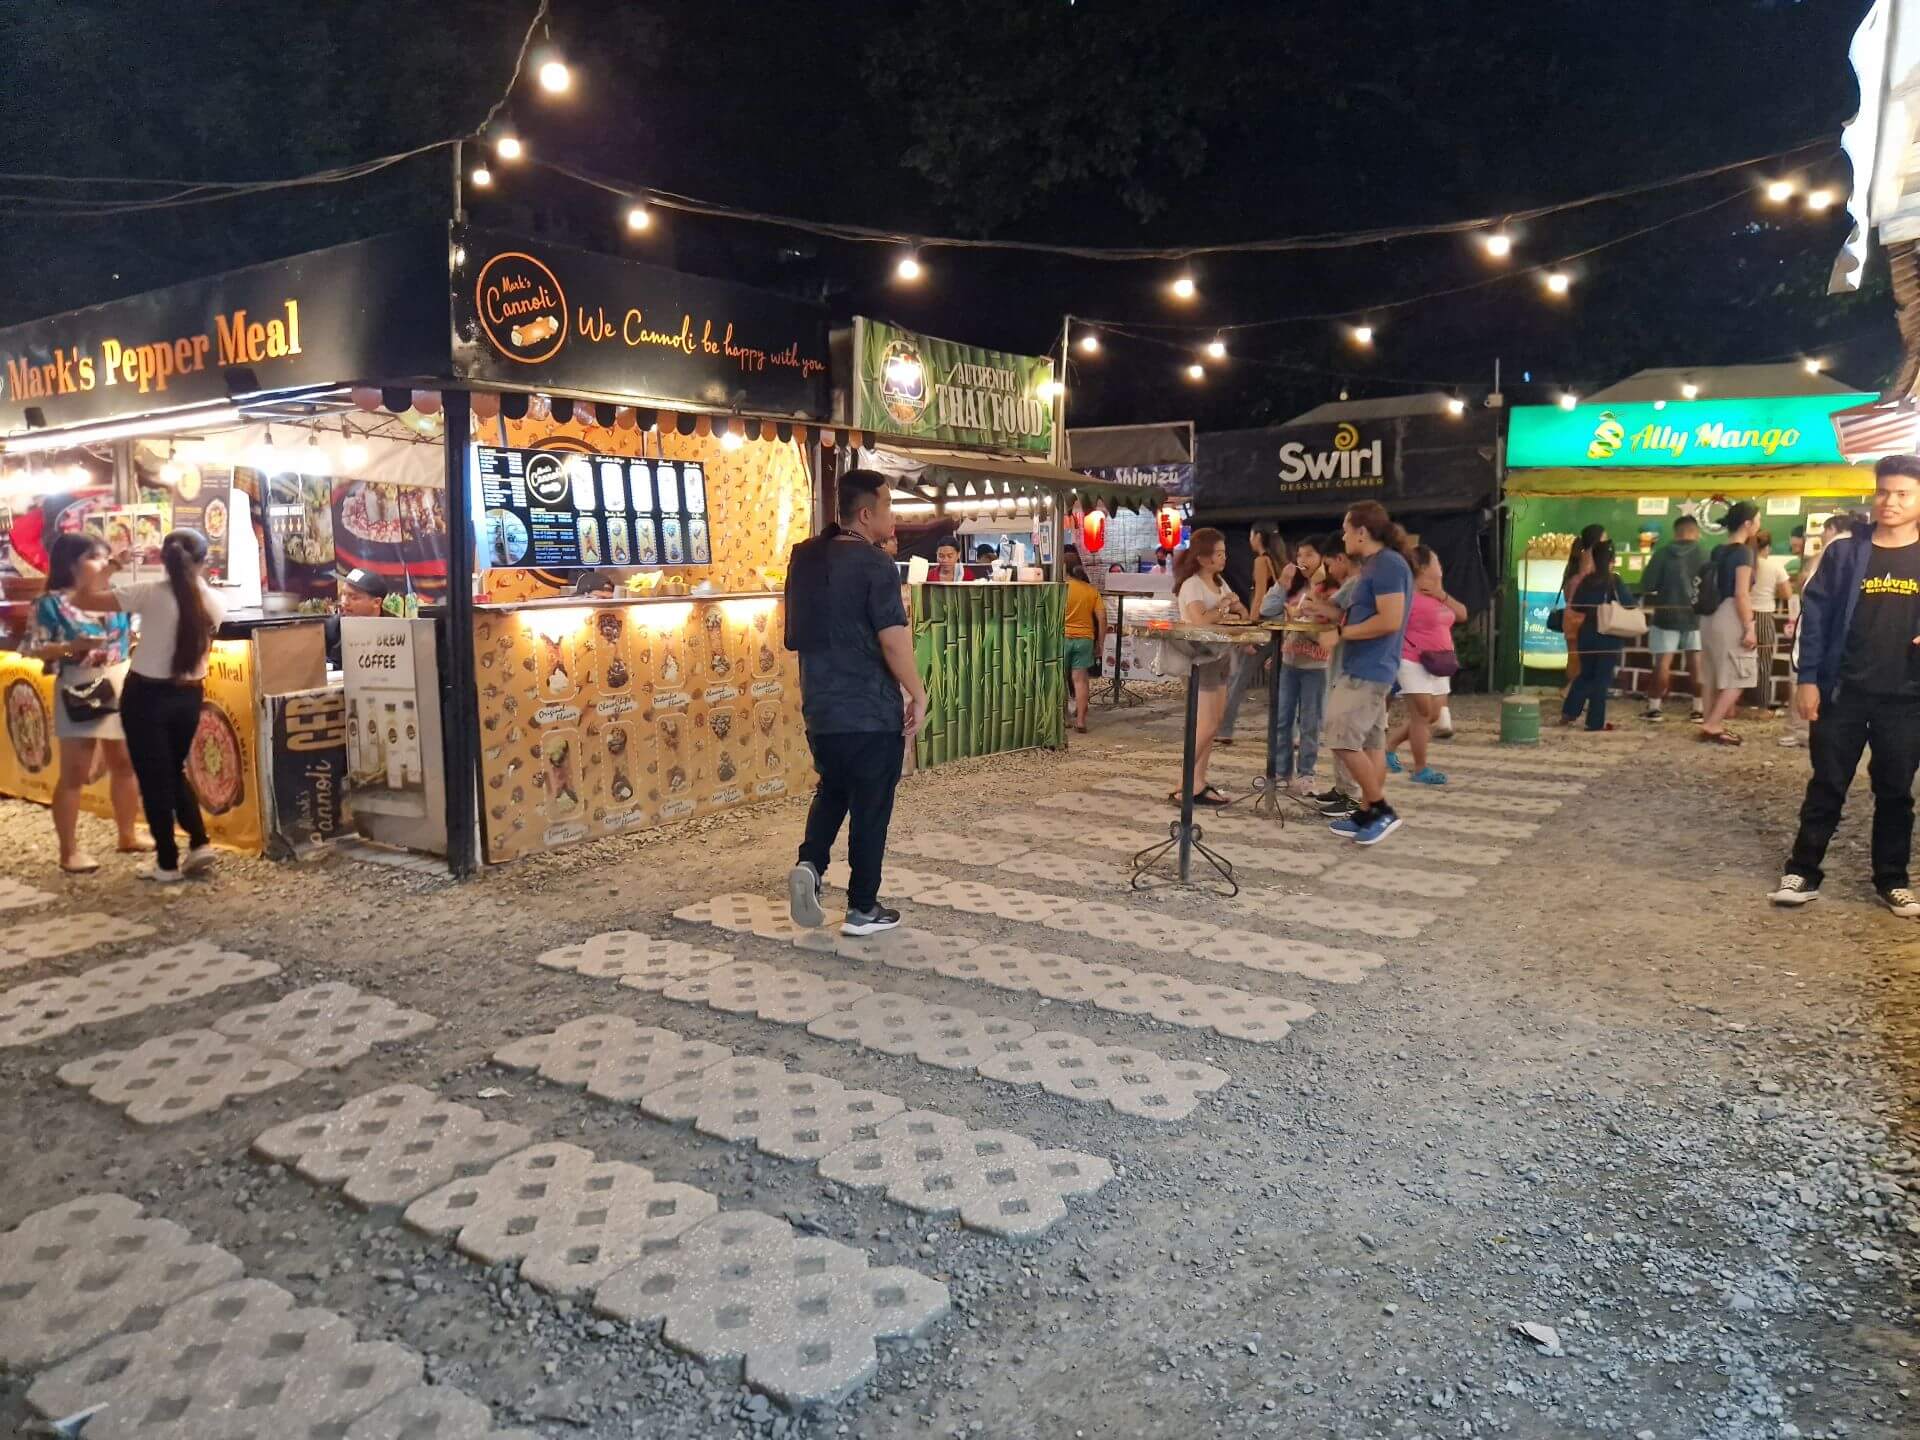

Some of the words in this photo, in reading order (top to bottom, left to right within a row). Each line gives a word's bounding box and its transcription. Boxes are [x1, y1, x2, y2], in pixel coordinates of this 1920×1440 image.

[502, 274, 532, 293] Mark's
[487, 286, 557, 324] Cannoli
[7, 345, 96, 401] Mark's
[102, 339, 209, 394] Pepper
[215, 299, 301, 366] Meal
[578, 306, 617, 342] We
[623, 308, 697, 355] Cannoli
[701, 319, 720, 354] be
[723, 322, 766, 372] happy
[770, 342, 800, 367] with
[801, 357, 825, 378] you
[946, 362, 1016, 392] AUTHENTIC
[935, 384, 988, 430] THAI
[991, 393, 1043, 437] FOOD
[1278, 424, 1383, 482] Swirl
[1630, 424, 1689, 458] Ally
[1694, 422, 1801, 456] Mango
[1115, 467, 1179, 486] Shimizu
[358, 654, 397, 669] COFFEE
